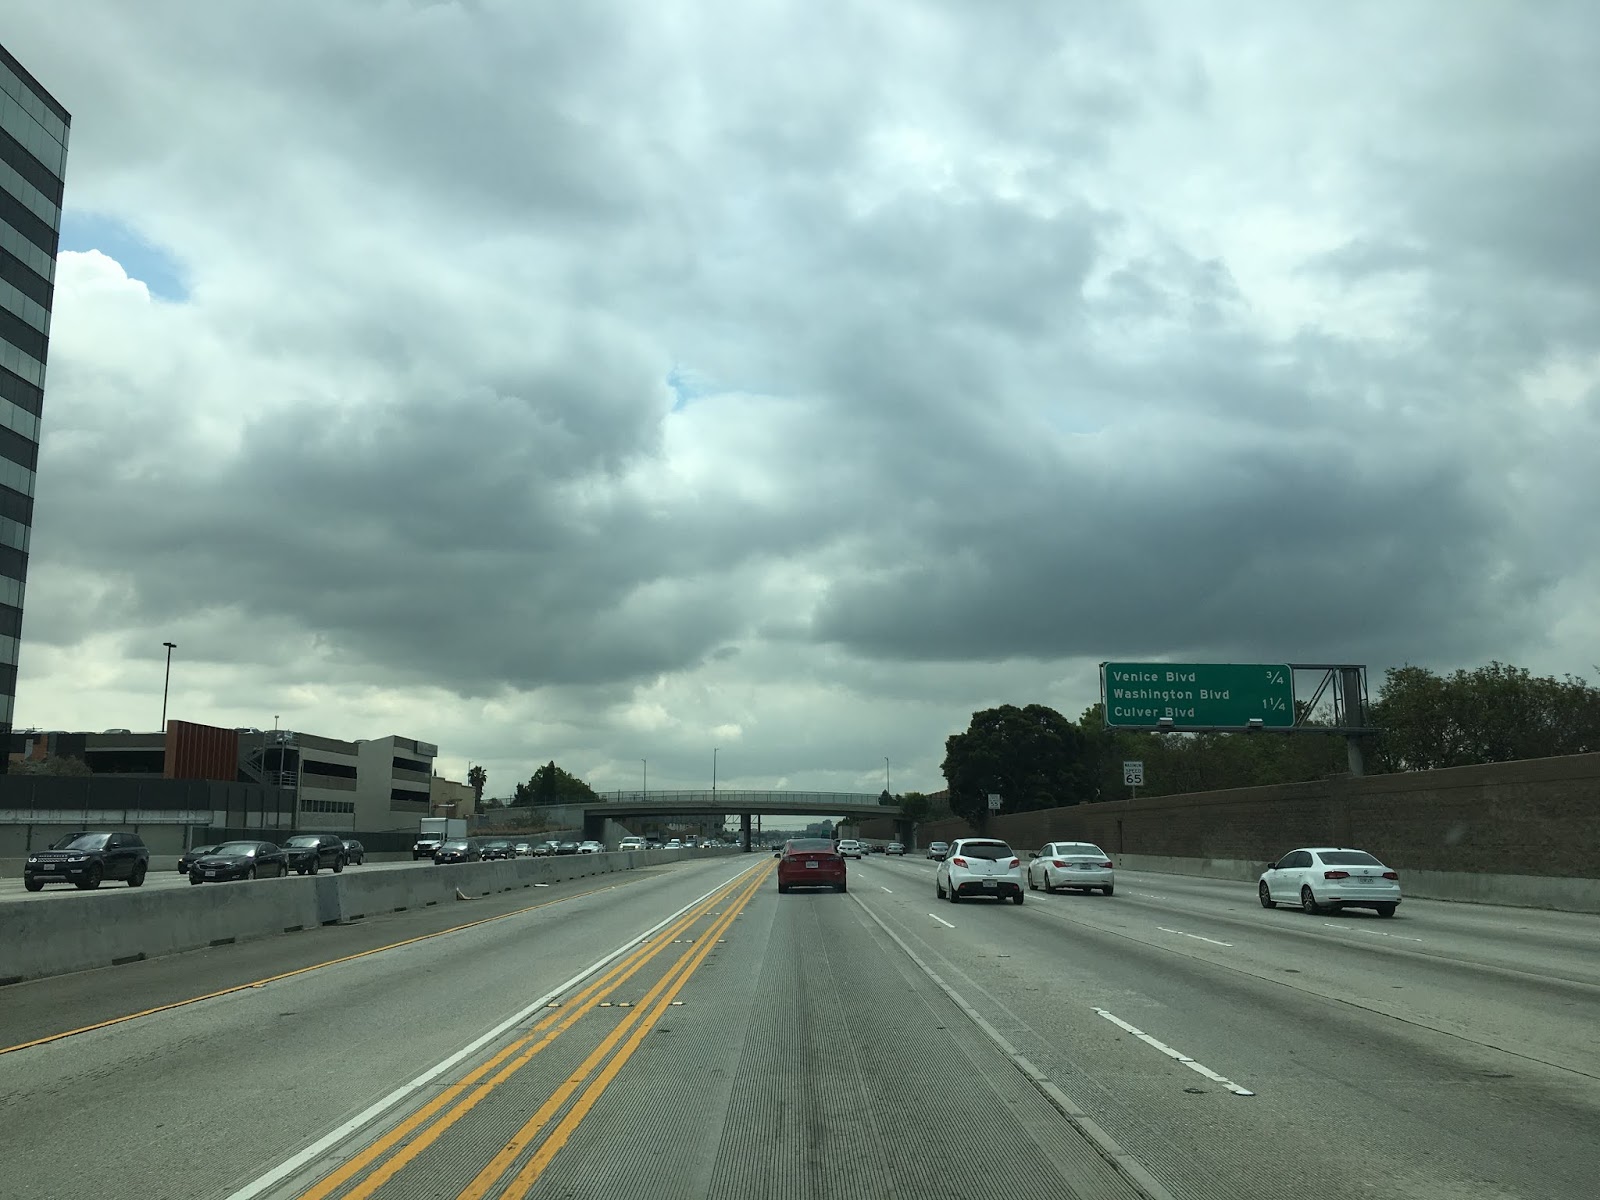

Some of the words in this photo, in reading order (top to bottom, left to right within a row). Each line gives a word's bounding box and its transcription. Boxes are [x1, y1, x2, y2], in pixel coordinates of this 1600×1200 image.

[1113, 671, 1158, 682] Venice
[1166, 672, 1196, 682] Blvd
[1114, 688, 1193, 701] Washington
[1200, 689, 1230, 700] Blvd
[1114, 706, 1158, 717] Culver
[1165, 707, 1195, 718] Blvd
[1126, 774, 1142, 784] 65
